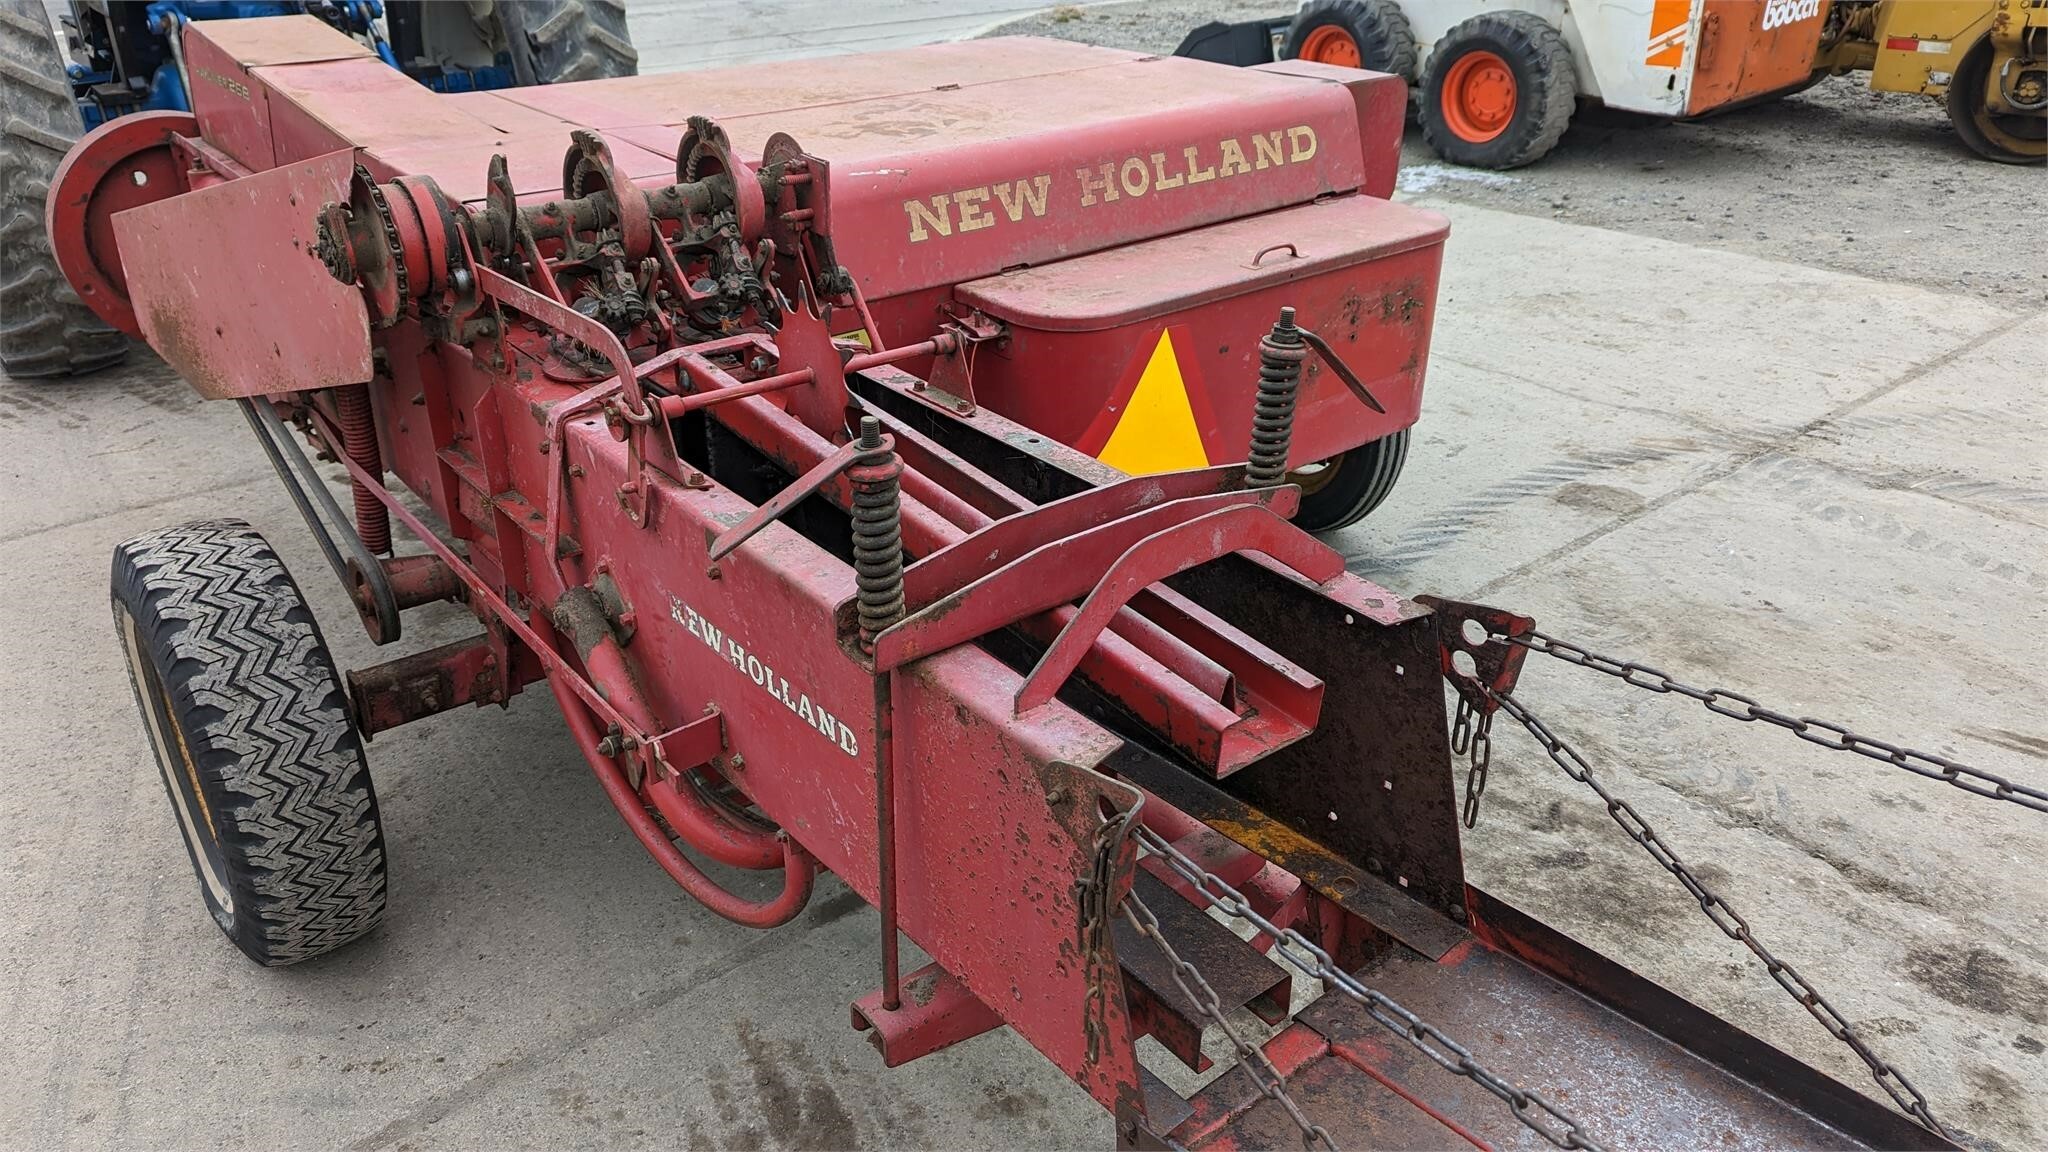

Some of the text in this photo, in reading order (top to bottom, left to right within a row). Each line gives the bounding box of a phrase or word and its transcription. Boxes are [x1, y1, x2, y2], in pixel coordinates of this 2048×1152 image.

[903, 125, 1319, 243] NEW HOLLAND
[669, 593, 859, 757] NEW HOLLAND
